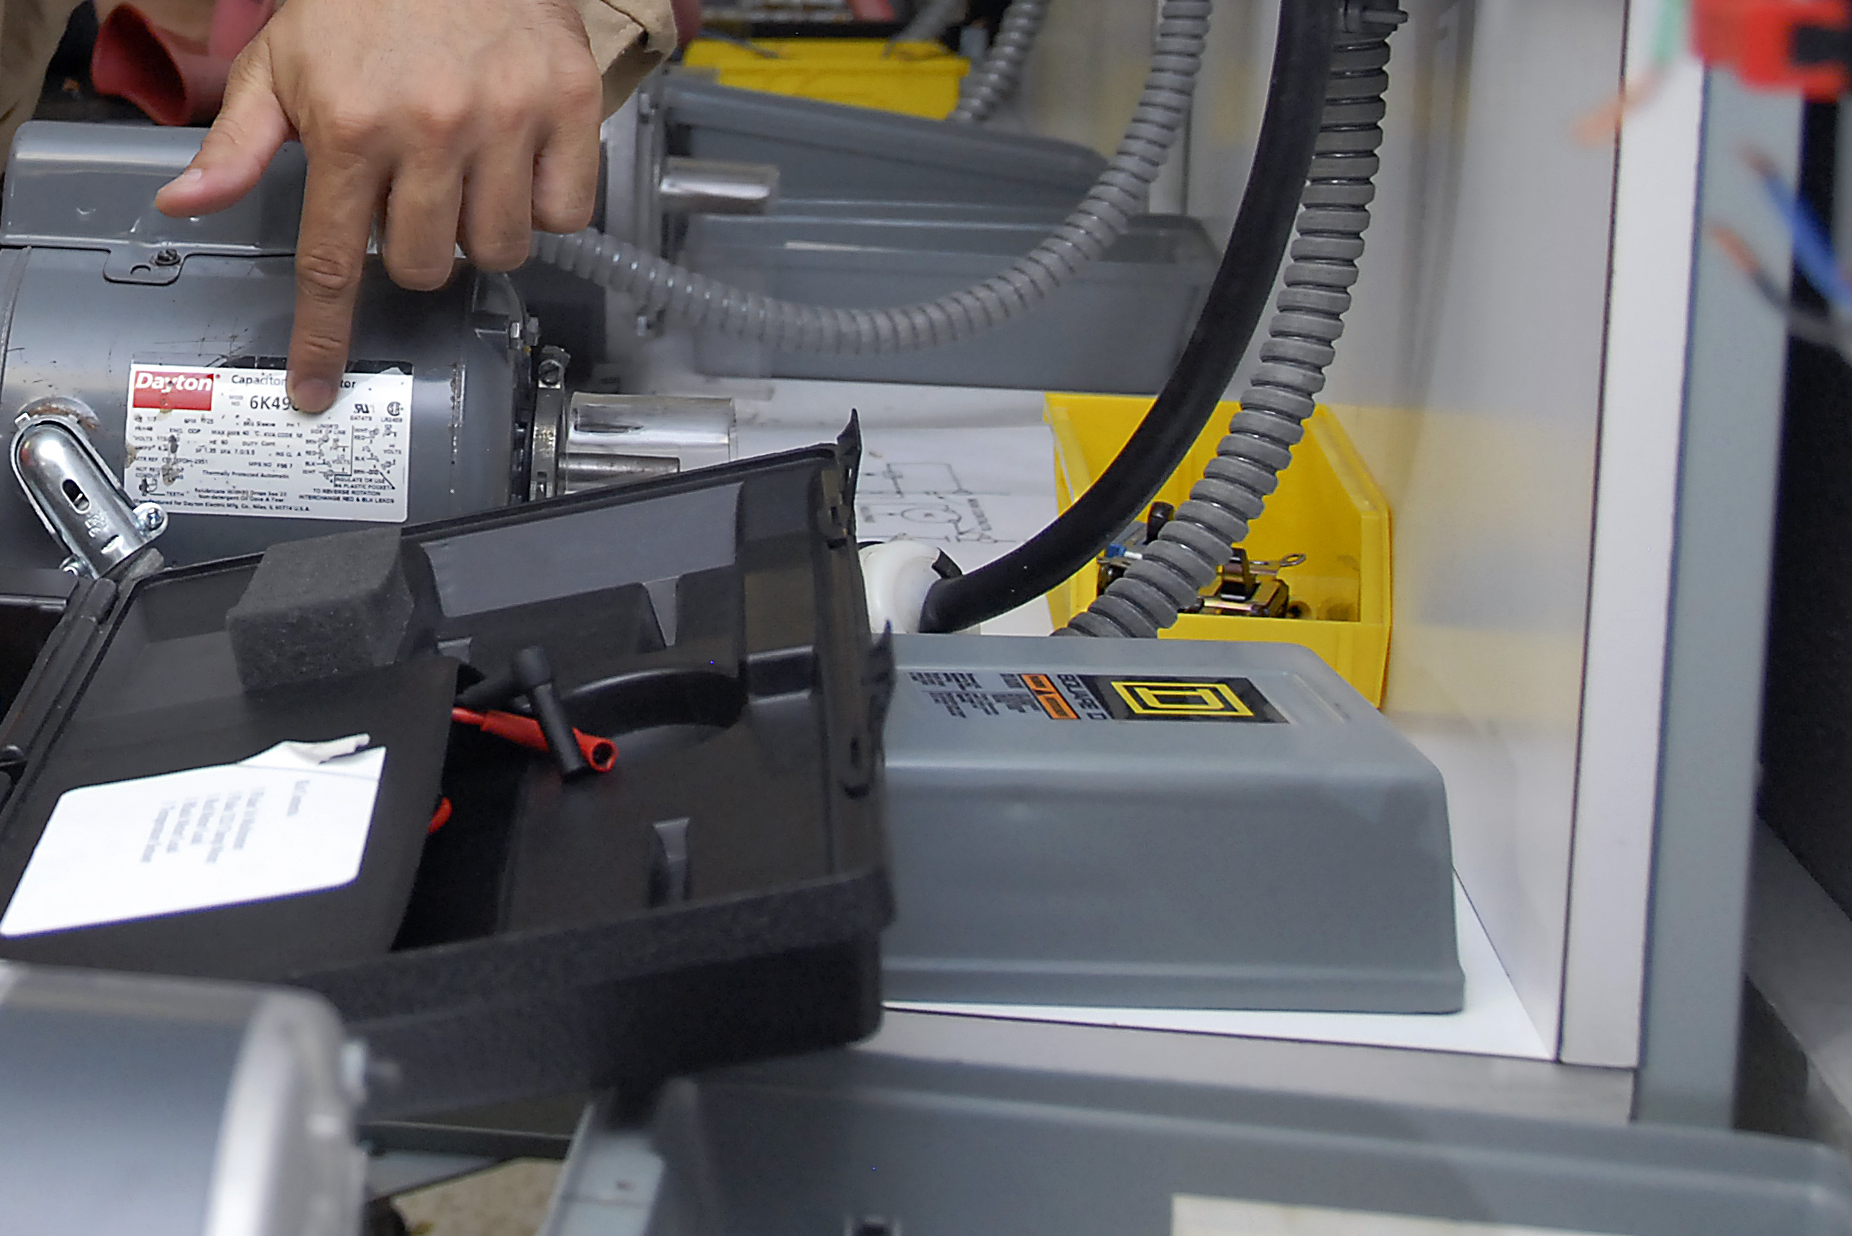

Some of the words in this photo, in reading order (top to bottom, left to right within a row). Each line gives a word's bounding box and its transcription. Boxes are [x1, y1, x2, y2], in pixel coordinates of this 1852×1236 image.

[135, 372, 214, 394] Dayton
[231, 373, 286, 387] Capacitor
[249, 395, 300, 411] 6K49
[1056, 673, 1098, 710] SQUARE
